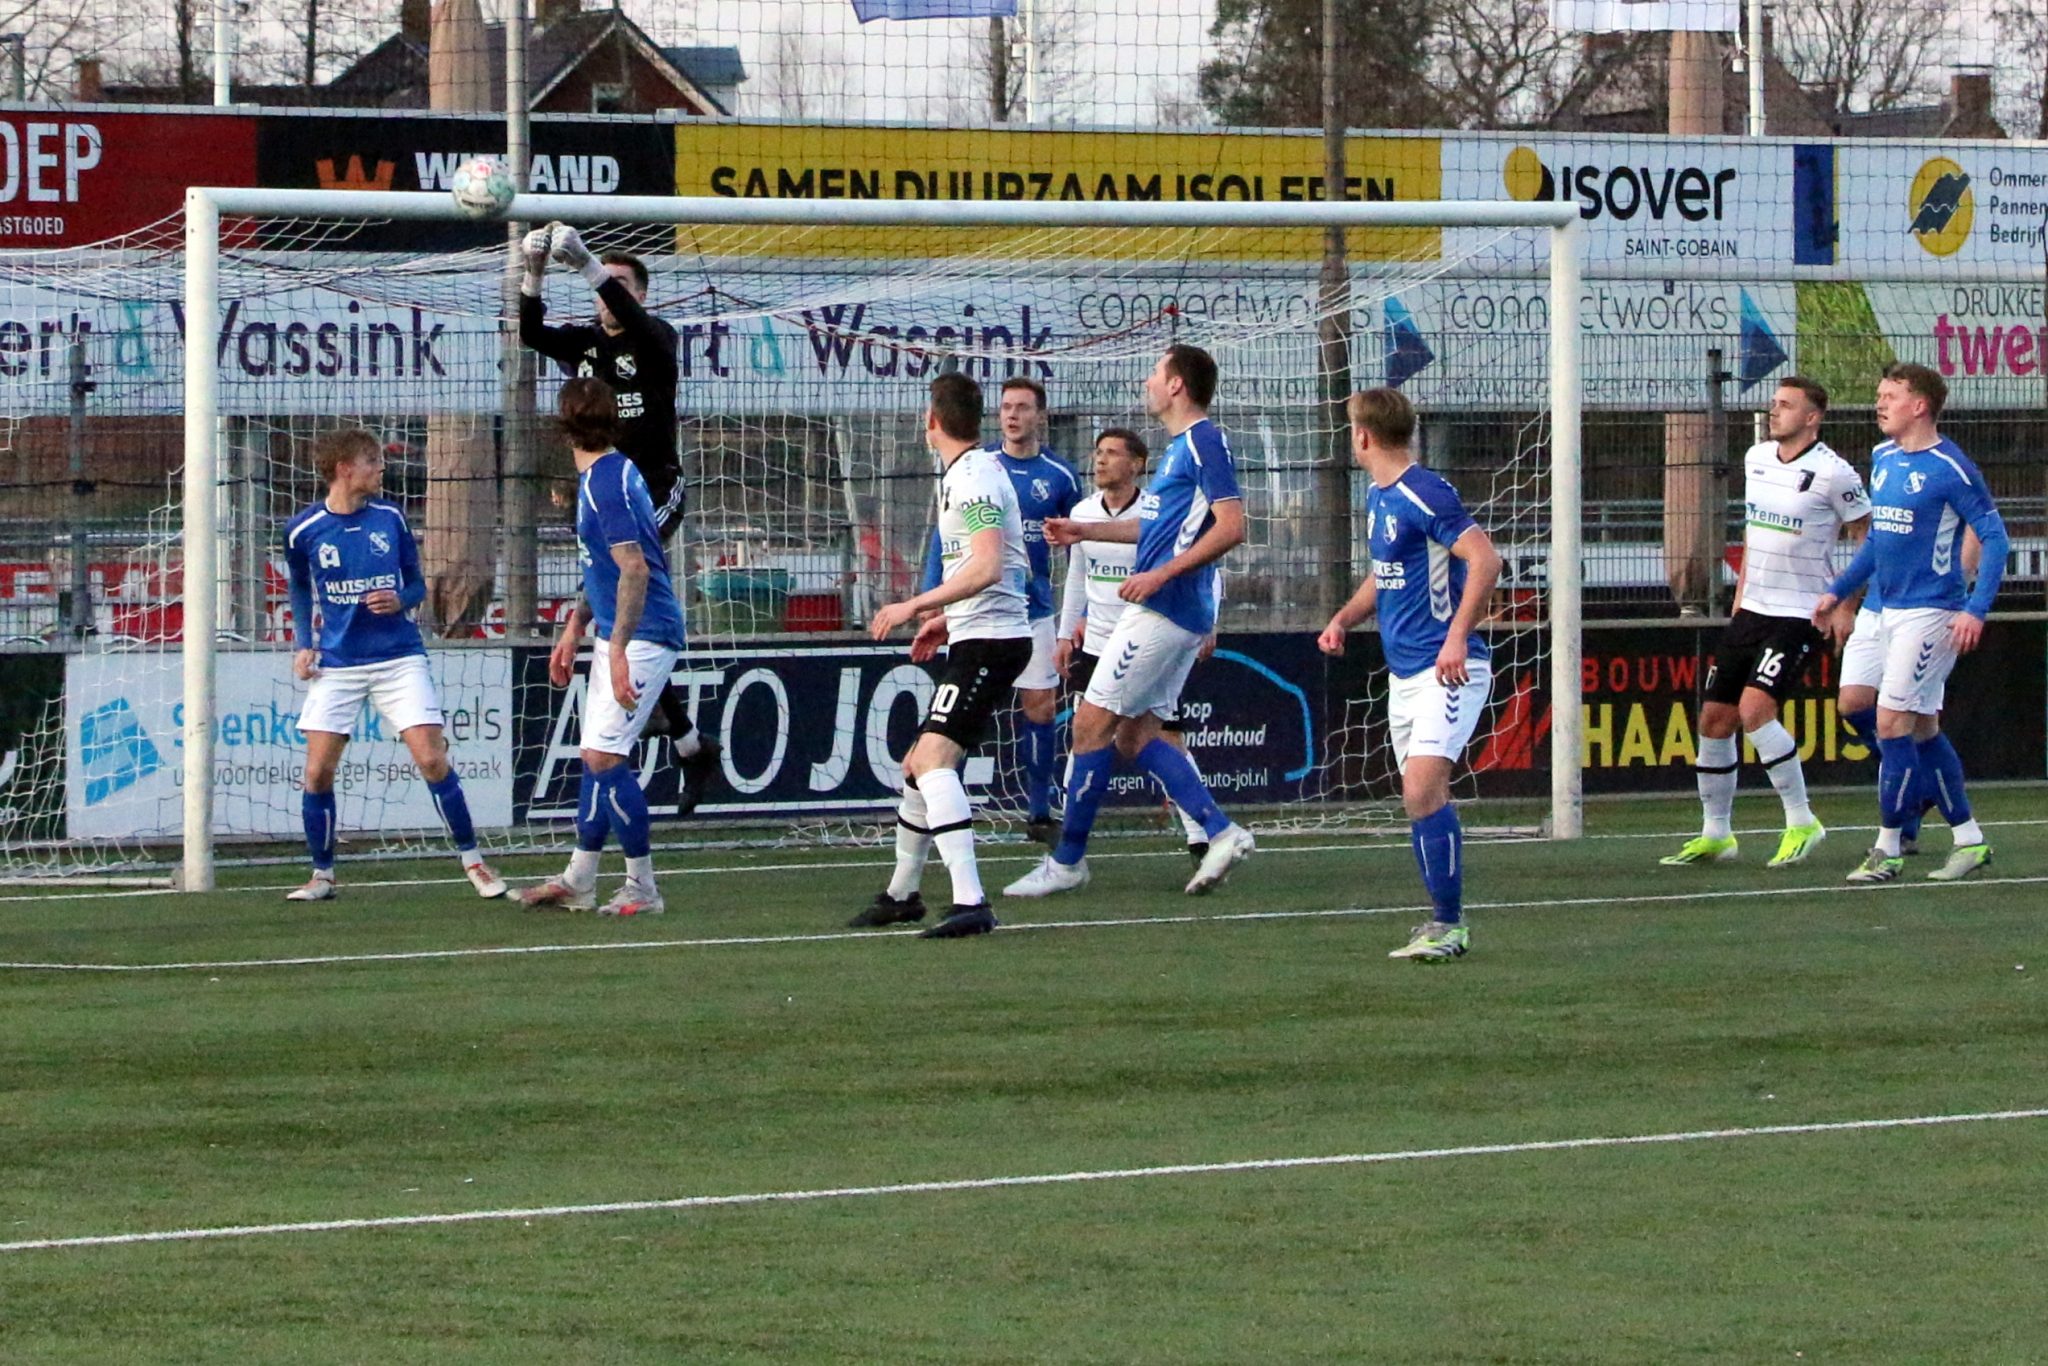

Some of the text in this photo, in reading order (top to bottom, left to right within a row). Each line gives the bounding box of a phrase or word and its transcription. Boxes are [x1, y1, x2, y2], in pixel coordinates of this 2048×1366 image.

[415, 152, 620, 193] WAND
[711, 166, 880, 199] SAMEN
[0, 216, 65, 236] STGOED
[1625, 238, 1738, 258] SAINT-GOBAIN
[1077, 286, 1372, 329] connectwos
[1450, 283, 1729, 330] connctworks
[169, 300, 448, 377] Wassink
[800, 303, 1055, 377] Wassink
[325, 574, 397, 594] HUISKES
[1757, 647, 1785, 678] 16
[930, 683, 961, 714] 10
[533, 667, 790, 799] ATO
